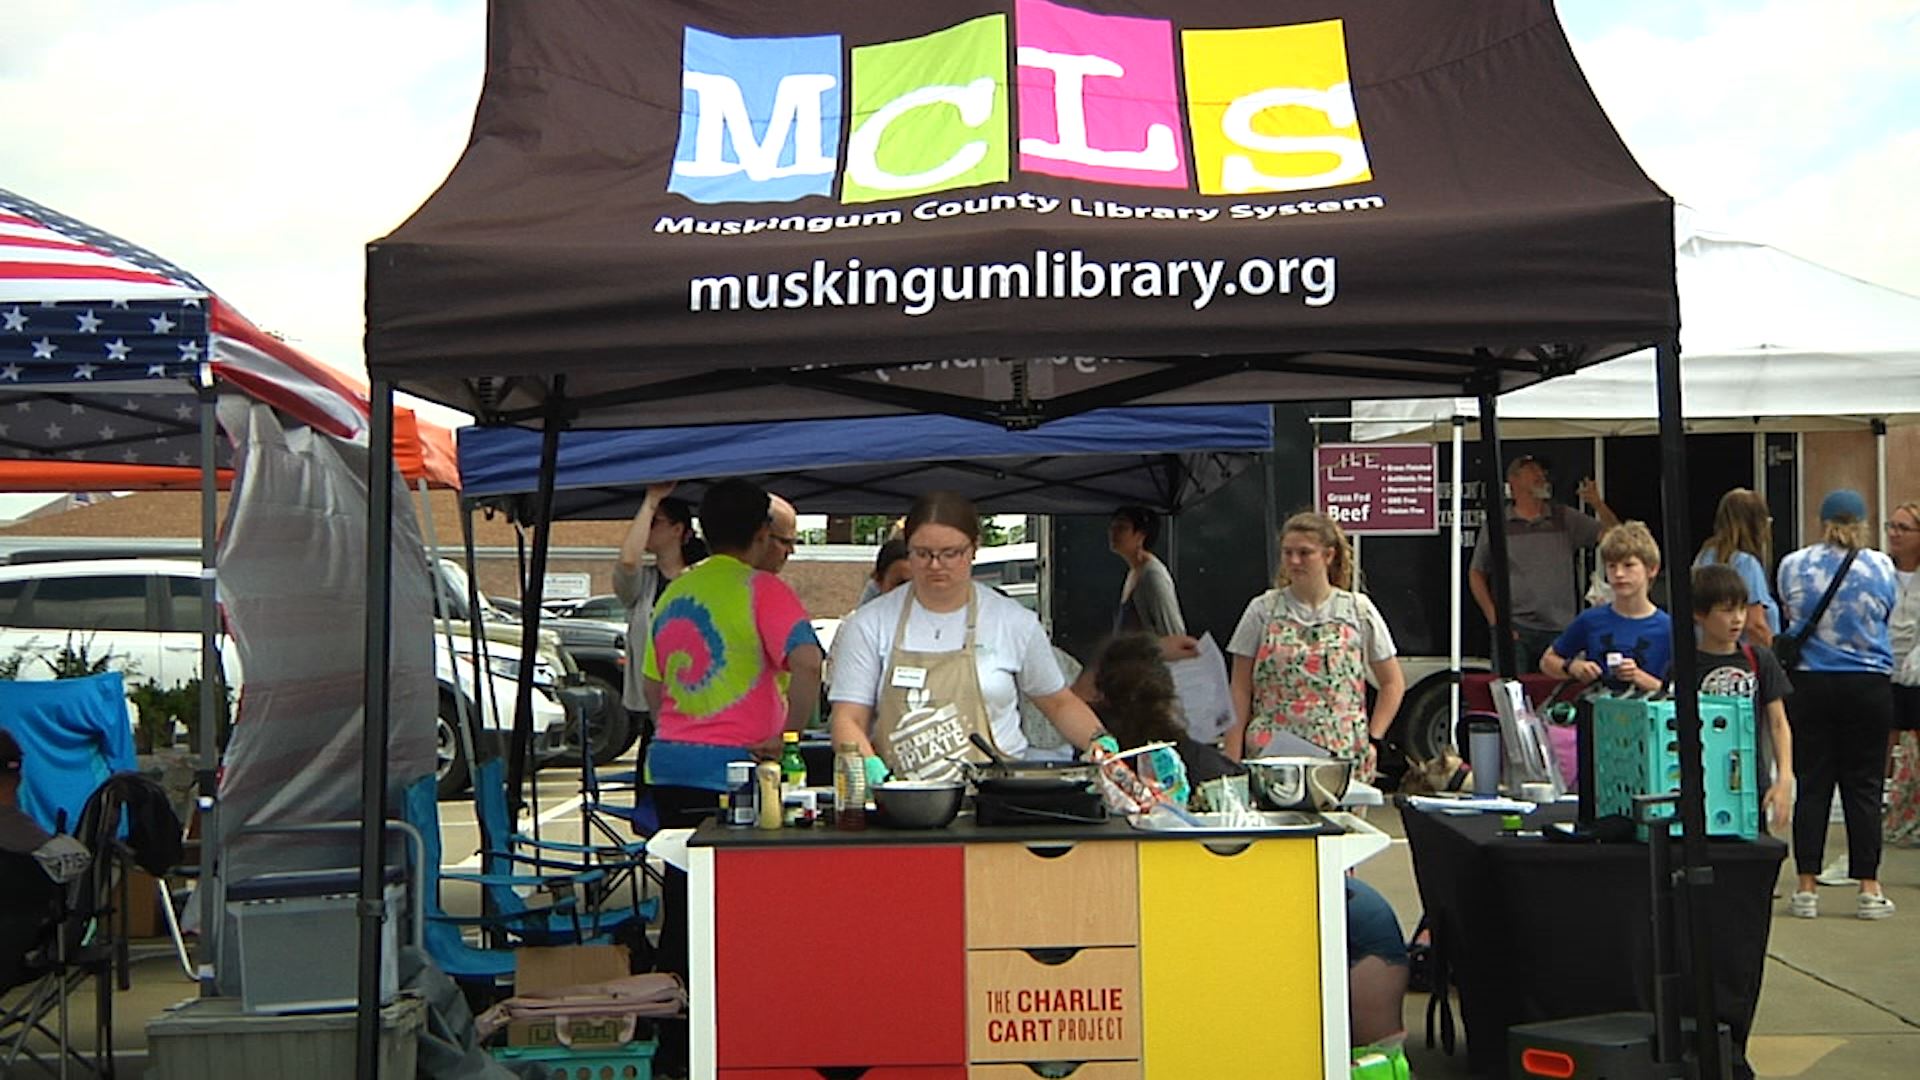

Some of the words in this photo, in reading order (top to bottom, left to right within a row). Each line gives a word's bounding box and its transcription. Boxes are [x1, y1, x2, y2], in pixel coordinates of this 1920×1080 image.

[674, 46, 1369, 193] MCLS
[654, 209, 902, 236] Muskingum
[912, 192, 1060, 221] County
[1070, 197, 1220, 222] Library
[1228, 194, 1385, 220] System
[689, 250, 1337, 315] muskingumlibrary.org
[1327, 493, 1352, 503] Grass
[1353, 492, 1371, 502] Fed
[1327, 503, 1371, 522] Beef
[987, 990, 1010, 1013] THE
[1017, 988, 1123, 1013] CHARLIE
[988, 1019, 1052, 1043] CART
[1058, 1017, 1123, 1041] PROJECT
